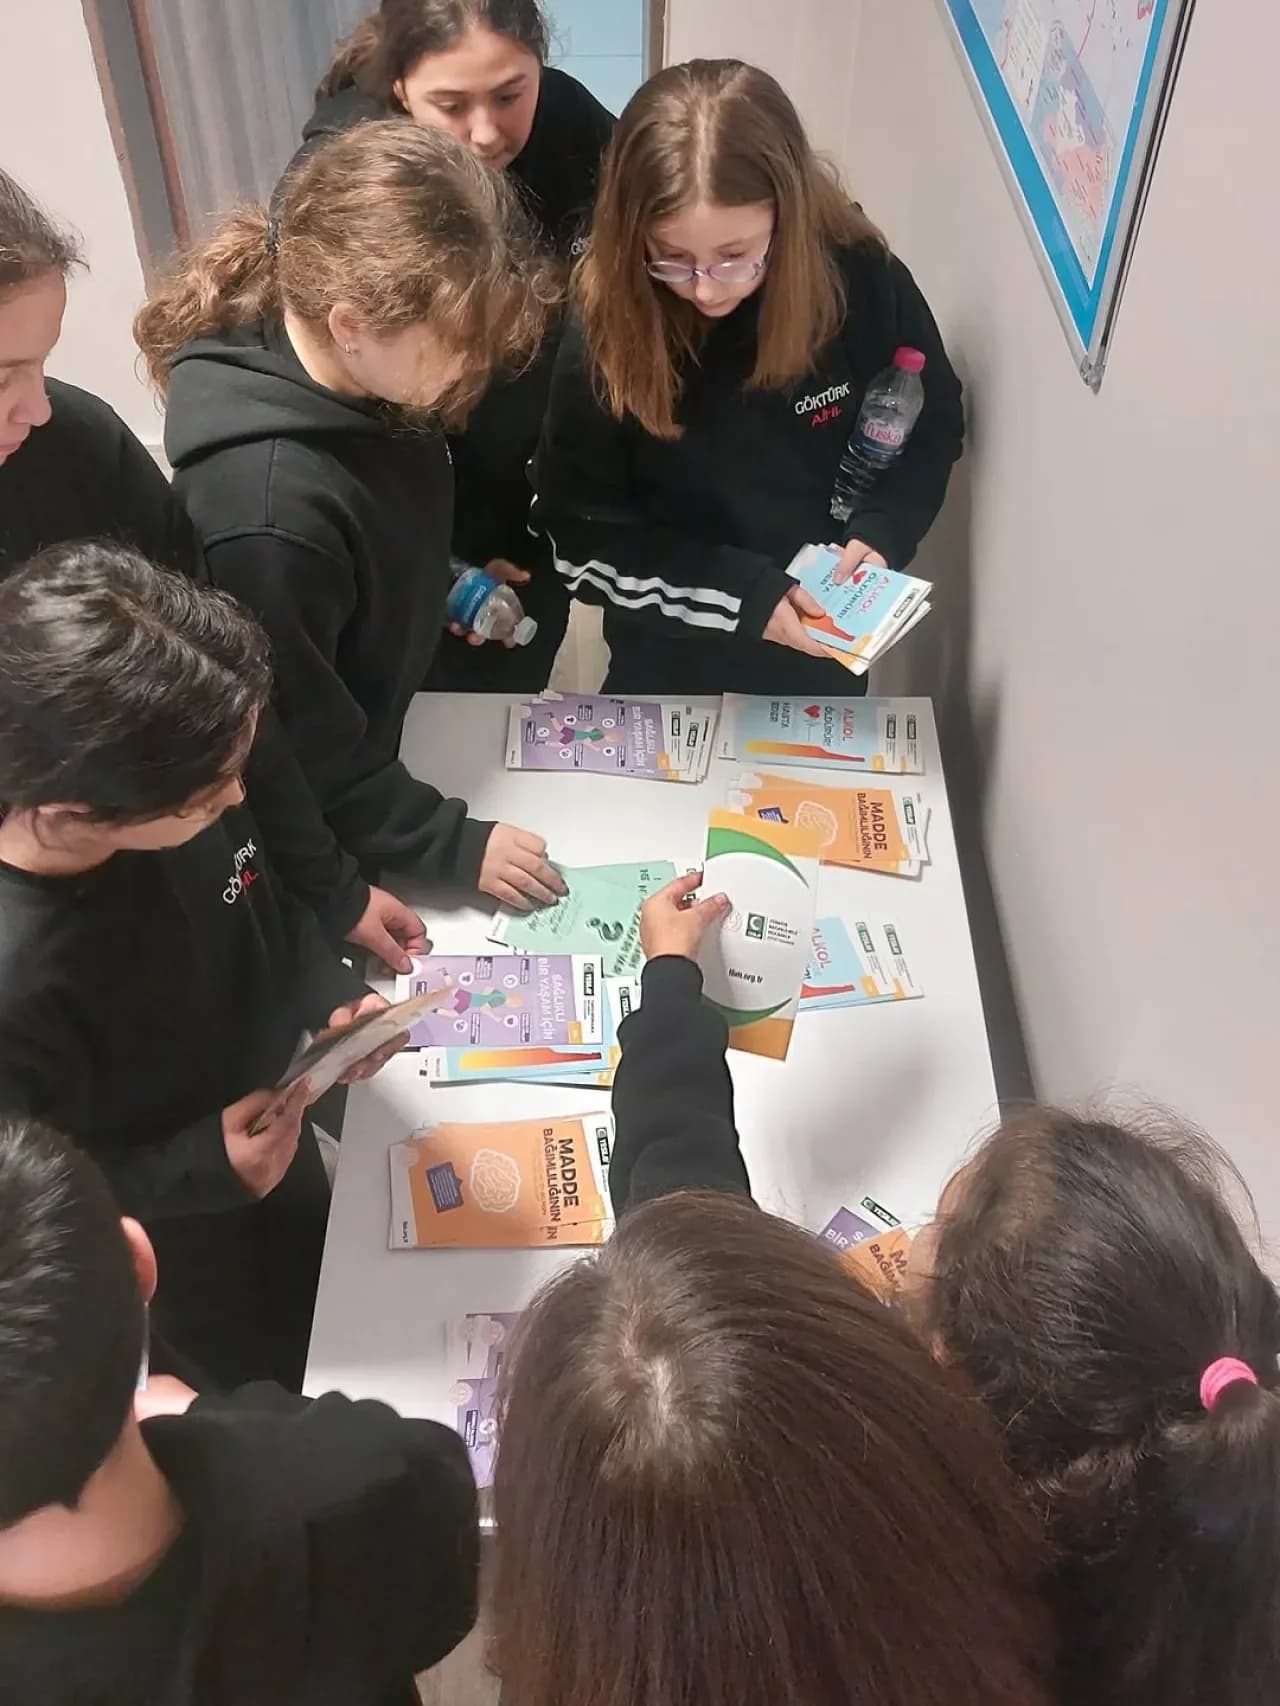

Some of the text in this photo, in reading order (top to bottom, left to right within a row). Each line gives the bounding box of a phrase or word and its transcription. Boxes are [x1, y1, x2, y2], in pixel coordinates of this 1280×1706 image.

[795, 382, 851, 415] GÖKTÜRK
[870, 801, 888, 851] MADDE
[537, 957, 550, 976] BİR
[538, 977, 553, 1016] YAŞAM
[550, 974, 566, 1023] SAĞLIKLI
[543, 1128, 562, 1222] BAĞIMLILIĞININ
[557, 1138, 580, 1208] MADDE
